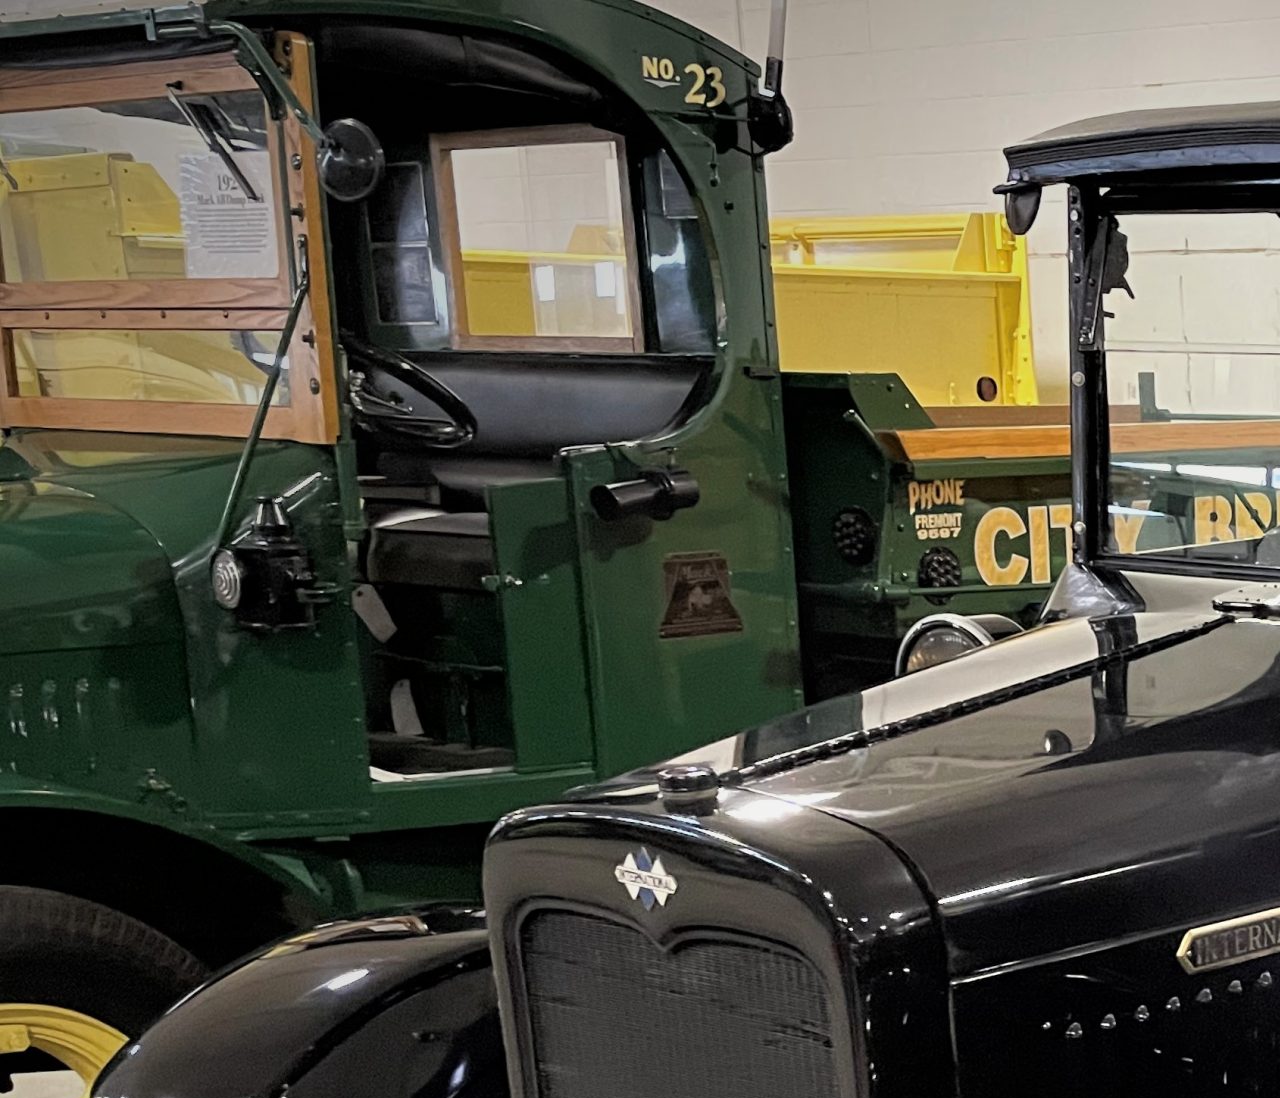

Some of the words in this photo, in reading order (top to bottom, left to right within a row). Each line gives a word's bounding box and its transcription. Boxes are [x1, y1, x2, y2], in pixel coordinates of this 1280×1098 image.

[642, 55, 681, 82] NO.
[684, 63, 726, 108] 23
[908, 479, 966, 516] PHONE
[914, 512, 962, 530] FREMONT
[974, 499, 1152, 586] CITY
